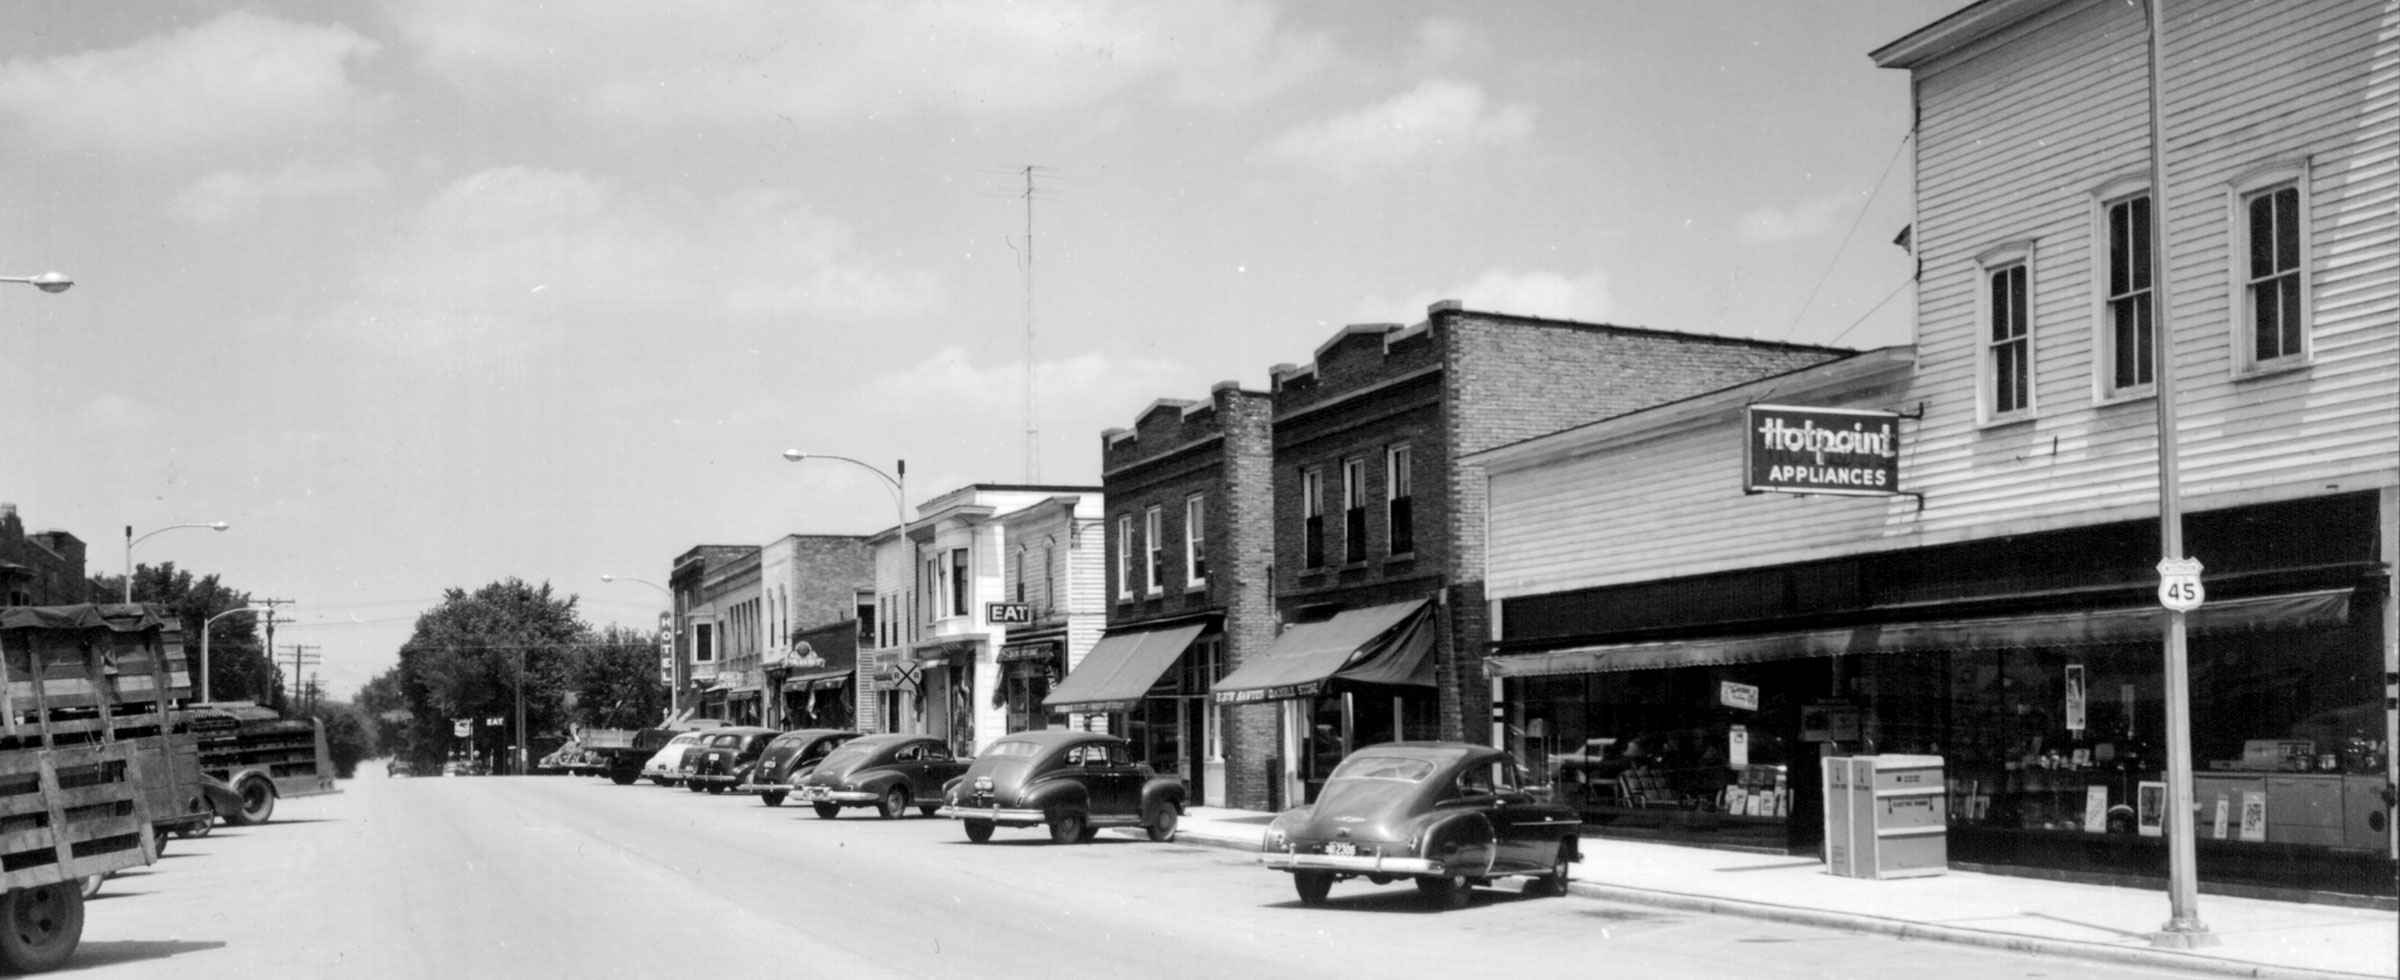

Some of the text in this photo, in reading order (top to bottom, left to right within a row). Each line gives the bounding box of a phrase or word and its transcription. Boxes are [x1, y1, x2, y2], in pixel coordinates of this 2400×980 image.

[1758, 417, 1896, 465] Hotpoint
[1769, 465, 1886, 486] APPLIANCES
[2168, 583, 2195, 601] 45
[991, 605, 1028, 621] EAT
[662, 617, 672, 682] HOTEL
[894, 671, 920, 679] R R
[486, 717, 504, 726] EAT
